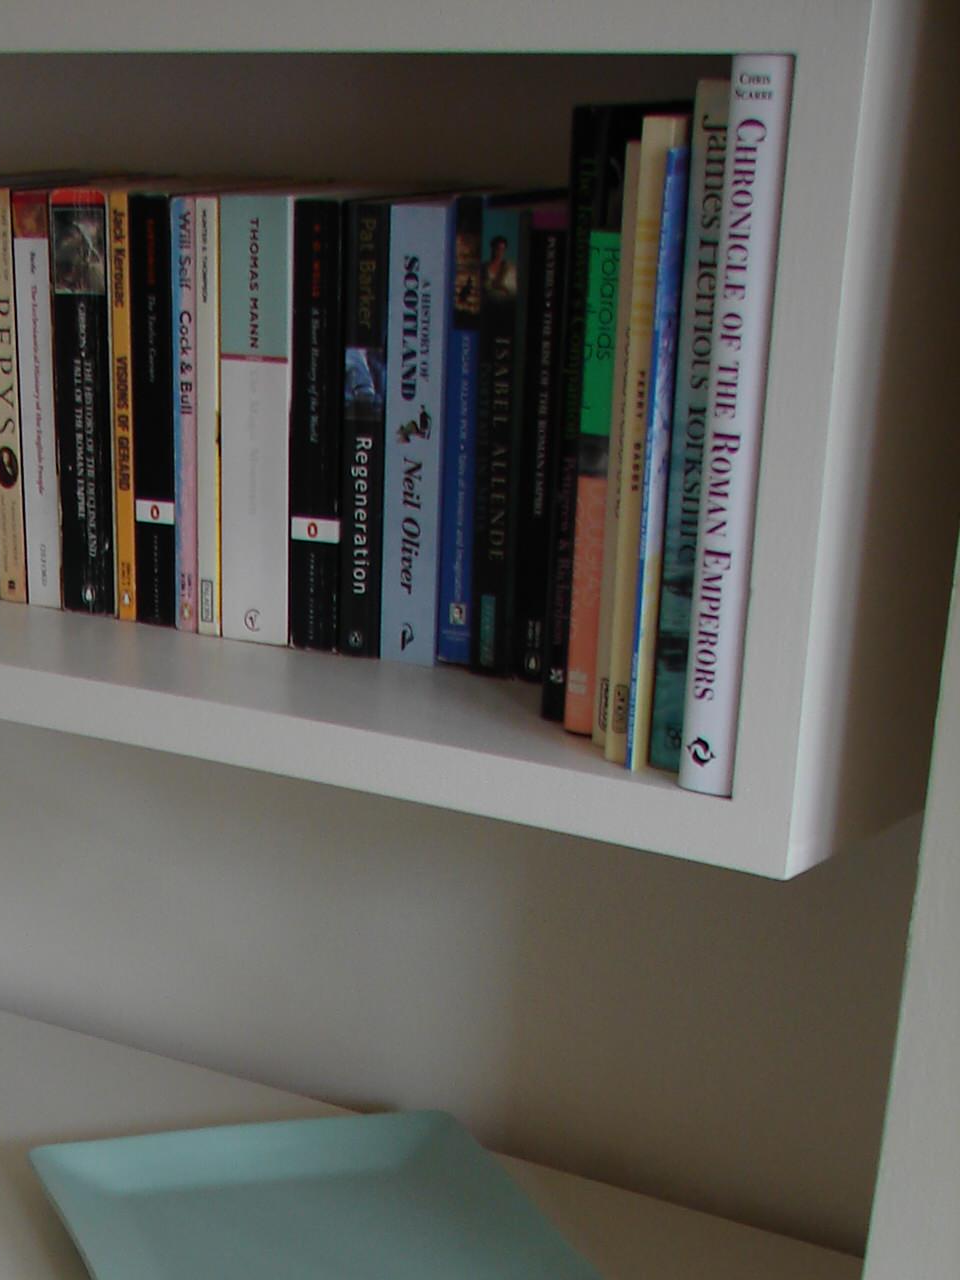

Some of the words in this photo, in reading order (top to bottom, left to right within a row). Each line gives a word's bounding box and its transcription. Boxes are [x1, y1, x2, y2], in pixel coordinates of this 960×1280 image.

[113, 208, 126, 244] Jack
[179, 210, 192, 250] Will
[359, 218, 377, 251] Pat
[723, 117, 768, 300] CHRONICLE
[114, 246, 127, 309] Kerouac
[178, 253, 192, 291] Self
[248, 217, 260, 292] THOMAS
[359, 260, 377, 330] Barker
[421, 279, 431, 290] A
[596, 247, 620, 361] Polaroids
[179, 309, 193, 357] Cock
[249, 297, 260, 349] MANN
[401, 255, 420, 402] SCOTLAND
[420, 293, 431, 356] HISTORY
[720, 312, 744, 352] OF
[116, 355, 130, 410] VISIONS
[179, 361, 193, 376] &
[419, 361, 430, 383] OF
[493, 336, 512, 426] ISABEL
[714, 361, 741, 420] THE
[118, 414, 129, 433] OF
[179, 381, 193, 416] Bull
[118, 435, 131, 492] GERARD
[401, 457, 423, 511] Neil
[705, 431, 742, 538] ROMAN
[351, 436, 374, 595] Regeneration
[489, 444, 508, 562] ALLENDE
[400, 517, 422, 595] Oliver
[693, 549, 733, 702] EMPERORS
